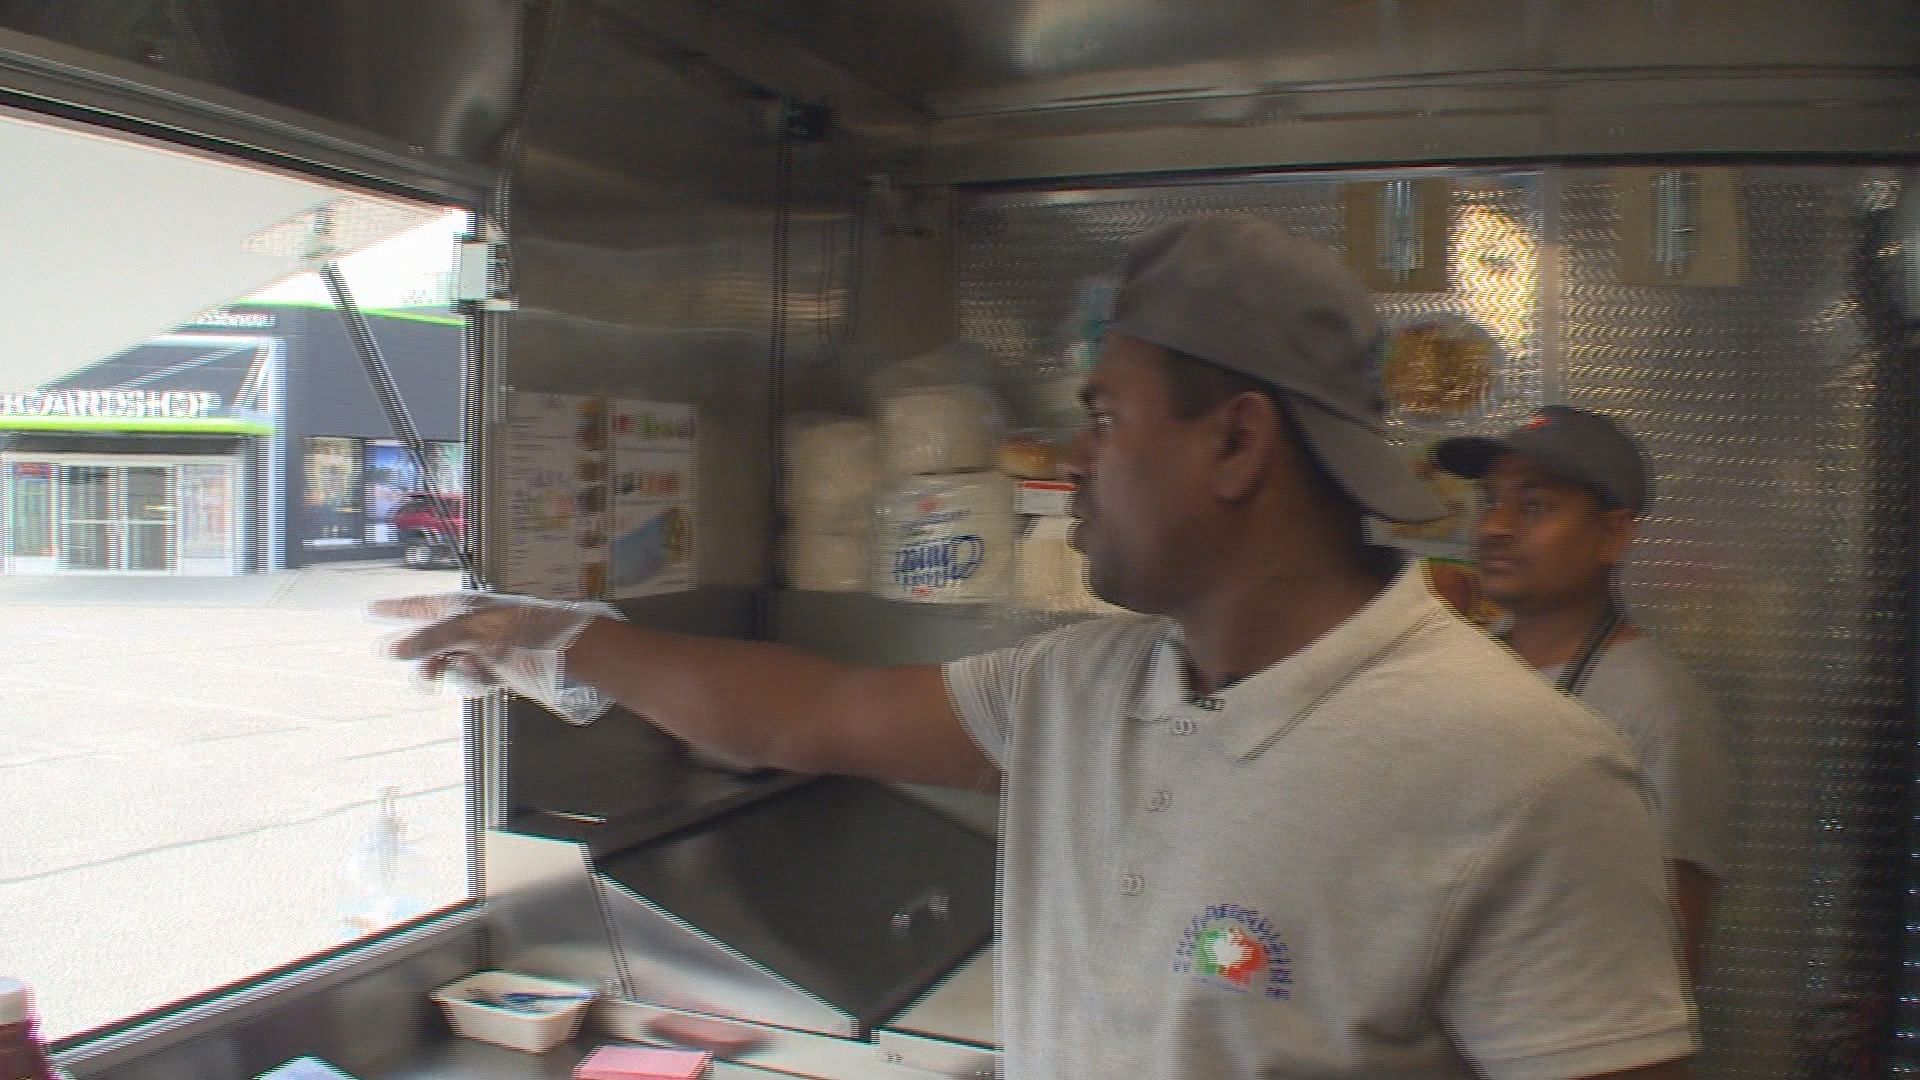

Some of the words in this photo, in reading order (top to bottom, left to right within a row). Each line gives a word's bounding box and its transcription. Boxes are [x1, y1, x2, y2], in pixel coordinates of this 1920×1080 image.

[0, 389, 221, 418] BOARDSHOP
[1205, 904, 1240, 921] DE
[1236, 909, 1294, 1002] CUISINE
